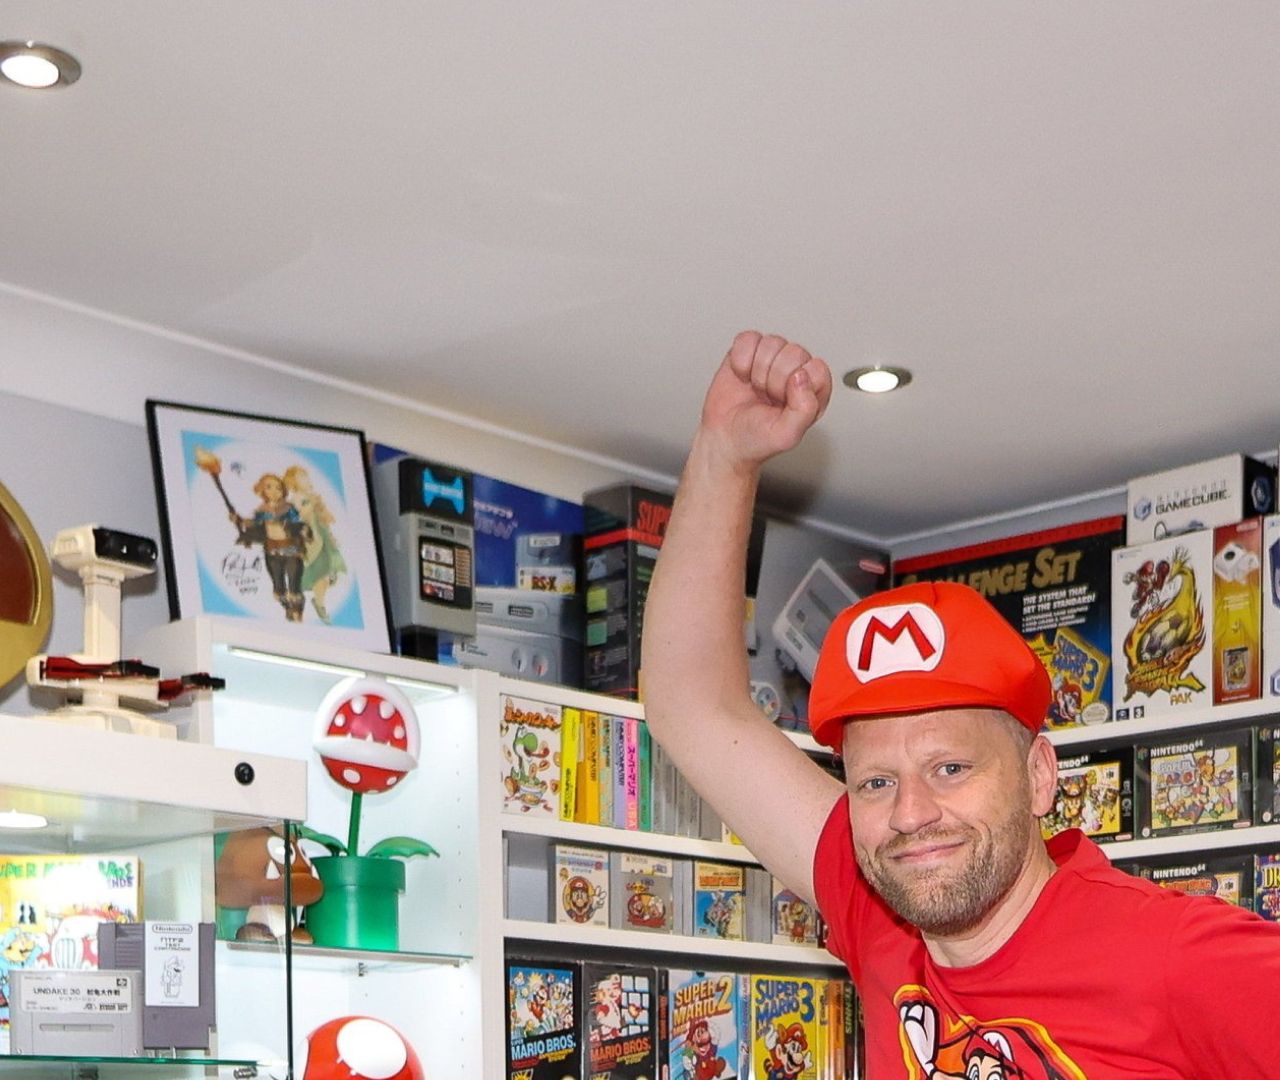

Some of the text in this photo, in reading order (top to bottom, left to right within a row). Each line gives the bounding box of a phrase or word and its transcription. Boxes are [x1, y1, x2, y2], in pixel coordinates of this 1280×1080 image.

[1156, 489, 1228, 515] GAMECUBE
[1032, 547, 1082, 588] SET
[858, 610, 938, 672] M
[674, 984, 716, 1006] SUPER
[755, 978, 799, 1004] SUPER
[755, 980, 815, 1026] MARIO 3
[672, 1000, 719, 1026] MARIO
[510, 1034, 577, 1061] MARIO BROS.
[589, 1044, 622, 1062] MARIO
